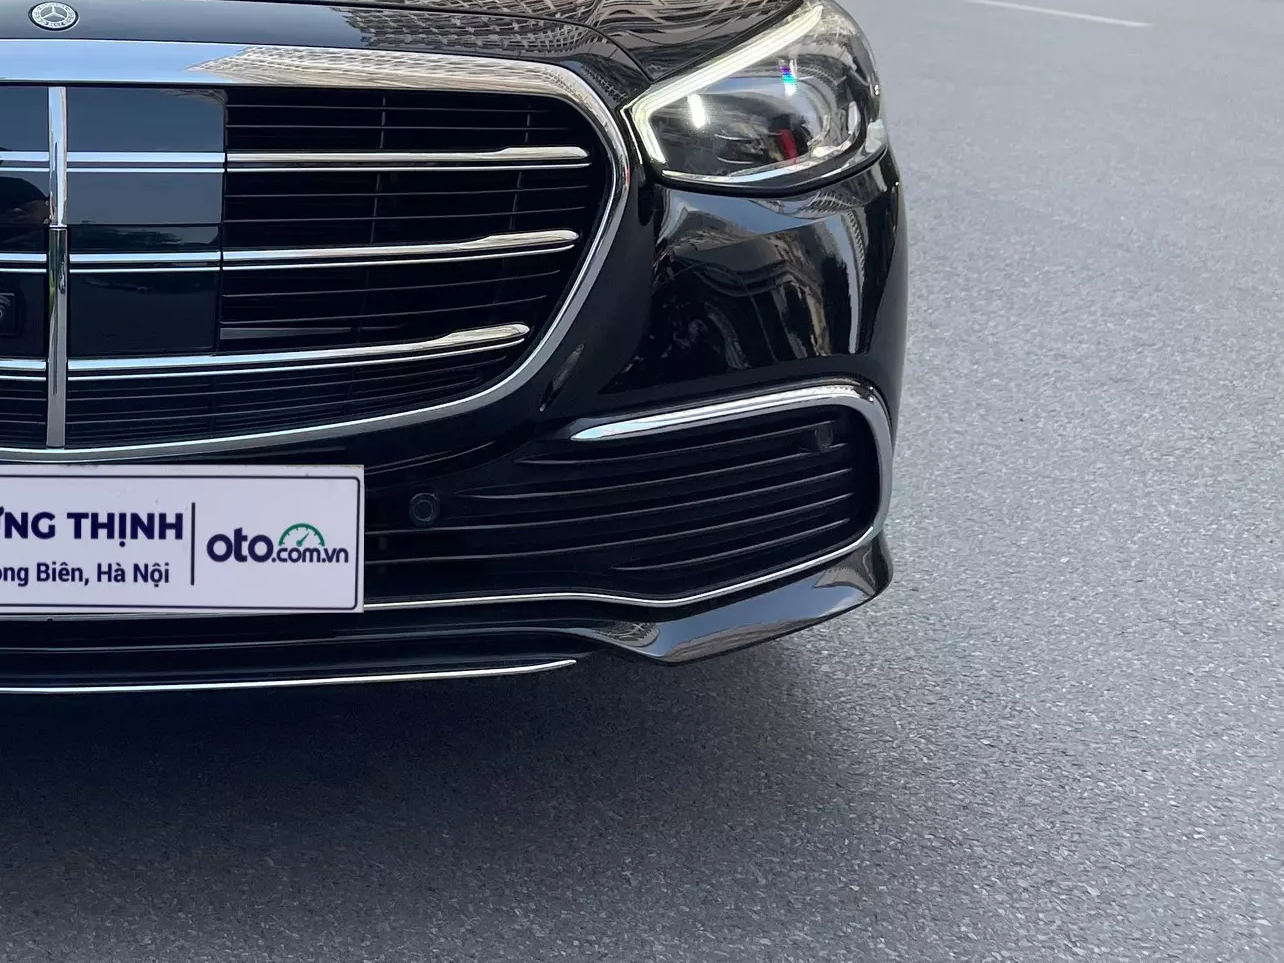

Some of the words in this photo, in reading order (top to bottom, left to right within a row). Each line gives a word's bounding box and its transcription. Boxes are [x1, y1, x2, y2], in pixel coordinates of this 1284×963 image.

[67, 512, 183, 547] THỊNH
[207, 527, 348, 563] oto.com.vn
[37, 562, 89, 586] Biên,
[97, 563, 126, 582] Hà
[134, 562, 169, 587] Nội
